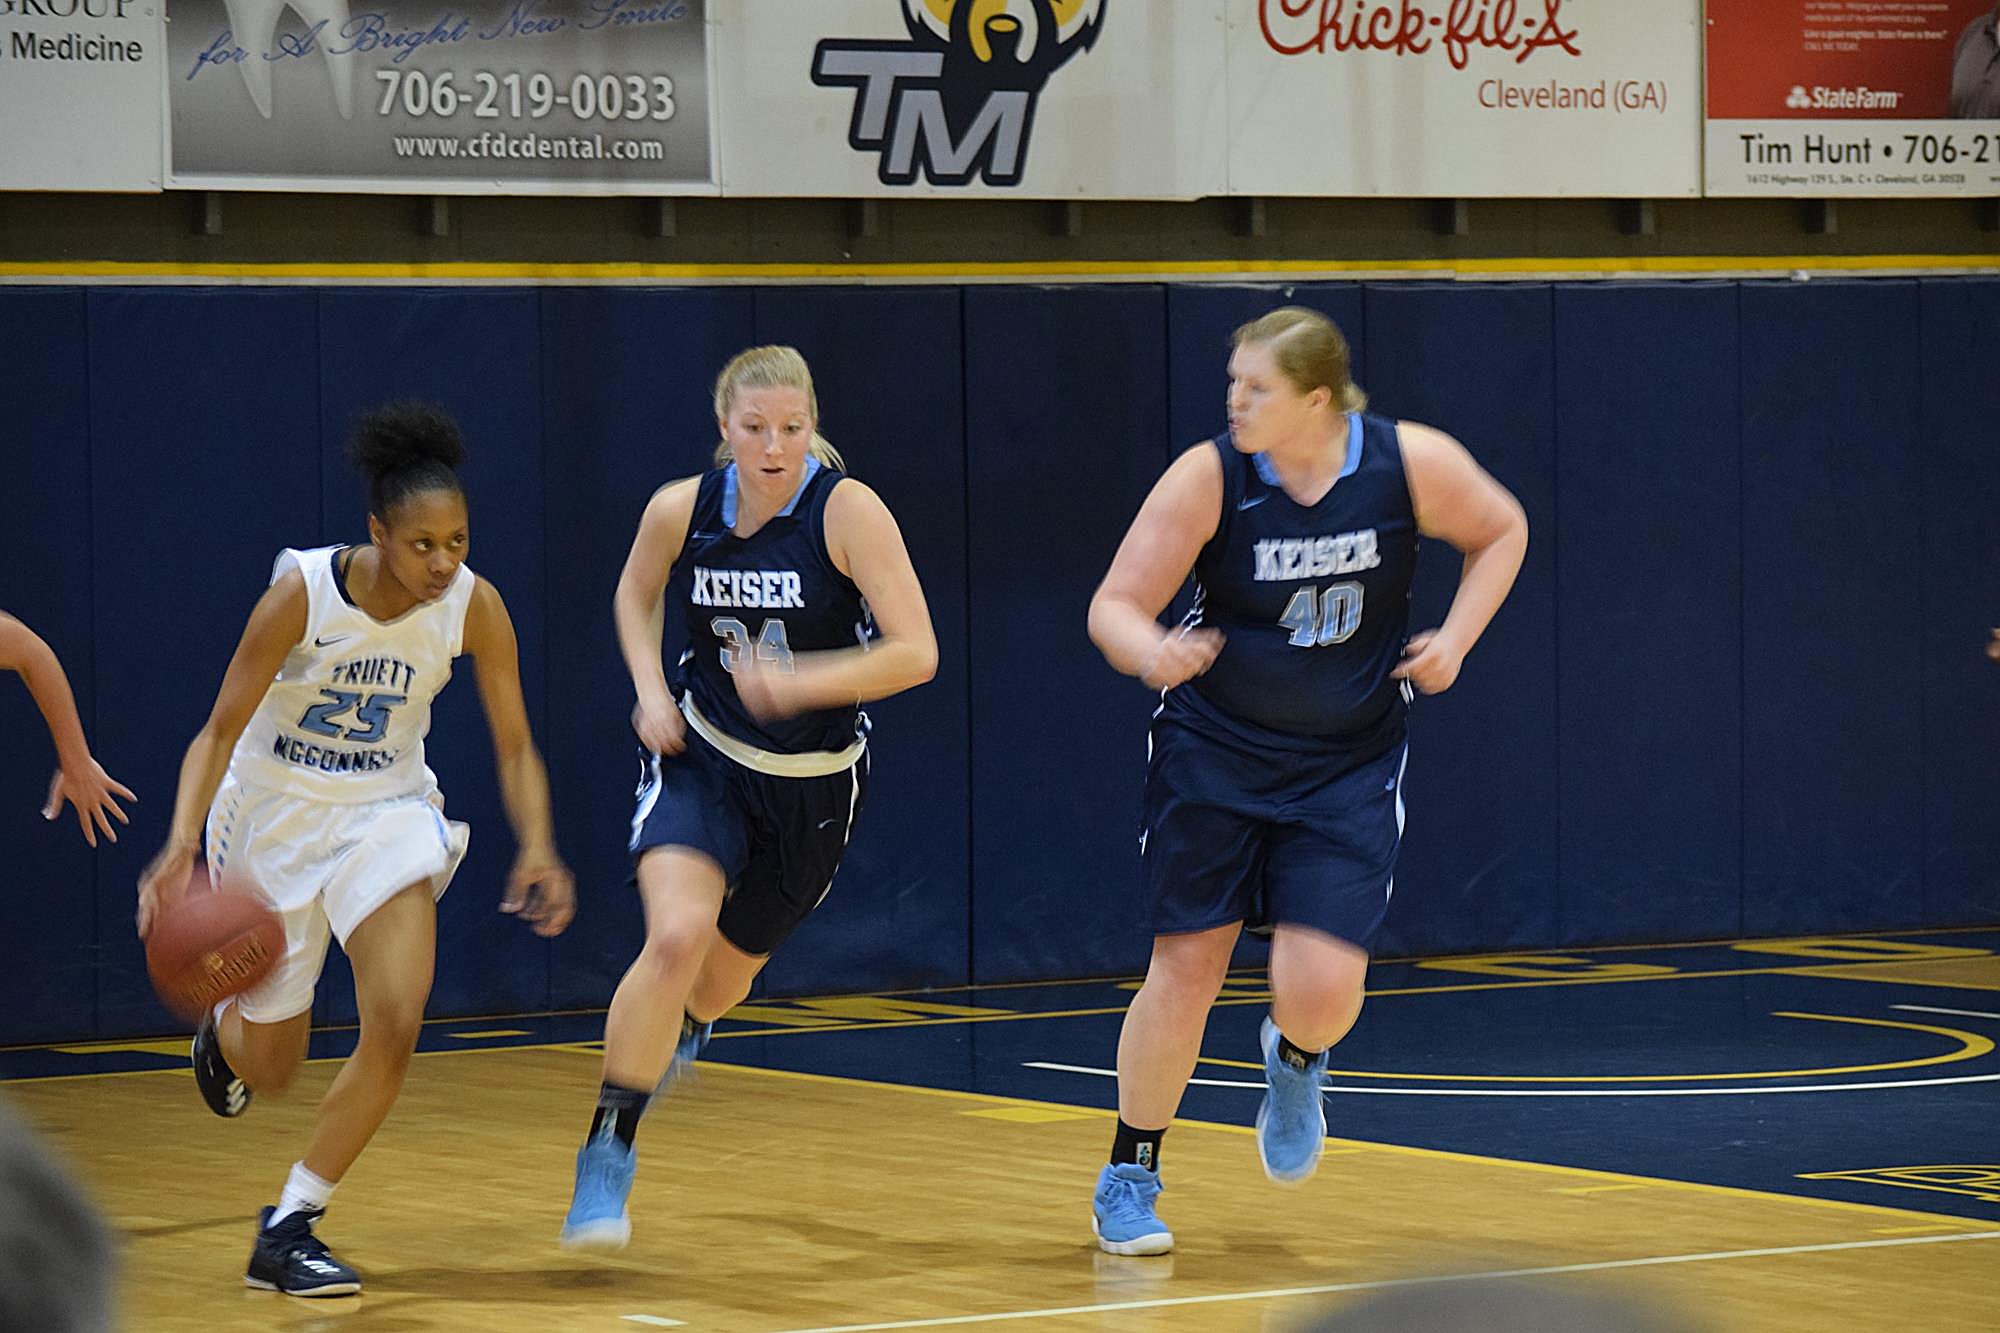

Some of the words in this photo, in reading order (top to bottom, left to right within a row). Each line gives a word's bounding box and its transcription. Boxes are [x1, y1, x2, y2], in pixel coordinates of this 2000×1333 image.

[12, 32, 143, 62] Medicine
[186, 30, 250, 81] for
[262, 19, 330, 61] A
[328, 13, 470, 63] Bright
[479, 0, 566, 40] New
[578, 0, 690, 30] Smile
[1258, 0, 1582, 70] Chick-fil-A
[375, 70, 676, 121] 706-219-0033
[815, 44, 1034, 181] TM
[1478, 79, 1606, 109] Cleveland
[1613, 80, 1668, 113] (GA)
[394, 132, 664, 160] www.cfdcdental.com
[1740, 133, 1792, 164] Tim
[1804, 134, 1872, 164] Hunt
[1252, 528, 1382, 582] KEISER
[691, 565, 806, 609] KEISER
[1277, 580, 1366, 648] 40
[710, 616, 796, 674] 34
[332, 657, 417, 695] TRUETT
[298, 688, 408, 743] 25
